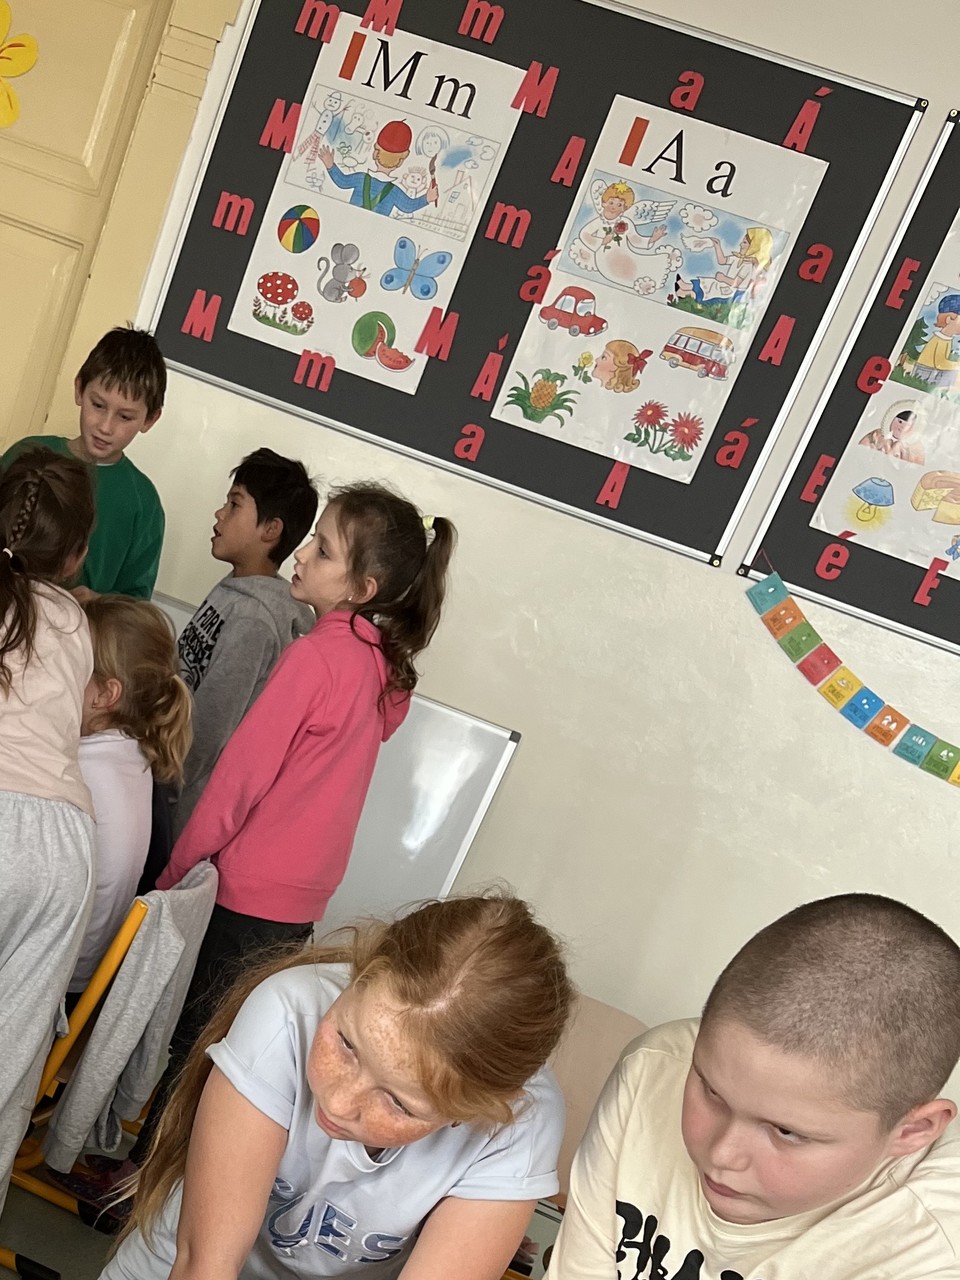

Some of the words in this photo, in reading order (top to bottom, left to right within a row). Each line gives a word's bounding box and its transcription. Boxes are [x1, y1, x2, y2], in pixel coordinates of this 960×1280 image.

[294, 0, 340, 44] m
[359, 0, 404, 36] M
[457, 0, 505, 44] m
[361, 38, 428, 100] M
[425, 75, 477, 119] m
[511, 61, 559, 118] M
[670, 70, 705, 112] a
[259, 99, 302, 154] M
[782, 86, 833, 153] Á
[551, 136, 586, 187] A
[642, 129, 686, 185] A
[706, 160, 737, 198] a
[212, 190, 254, 235] m
[485, 202, 531, 248] m
[519, 248, 562, 304] á
[798, 243, 833, 284] a
[885, 257, 920, 309] E
[180, 289, 222, 342] M
[414, 307, 459, 361] M
[758, 315, 796, 366] A
[293, 349, 336, 392] m
[470, 333, 509, 401] Á
[857, 355, 892, 395] e
[454, 424, 485, 462] a
[715, 418, 759, 469] á
[595, 461, 630, 509] A
[800, 454, 837, 504] E
[815, 530, 857, 581] é
[914, 557, 950, 606] E
